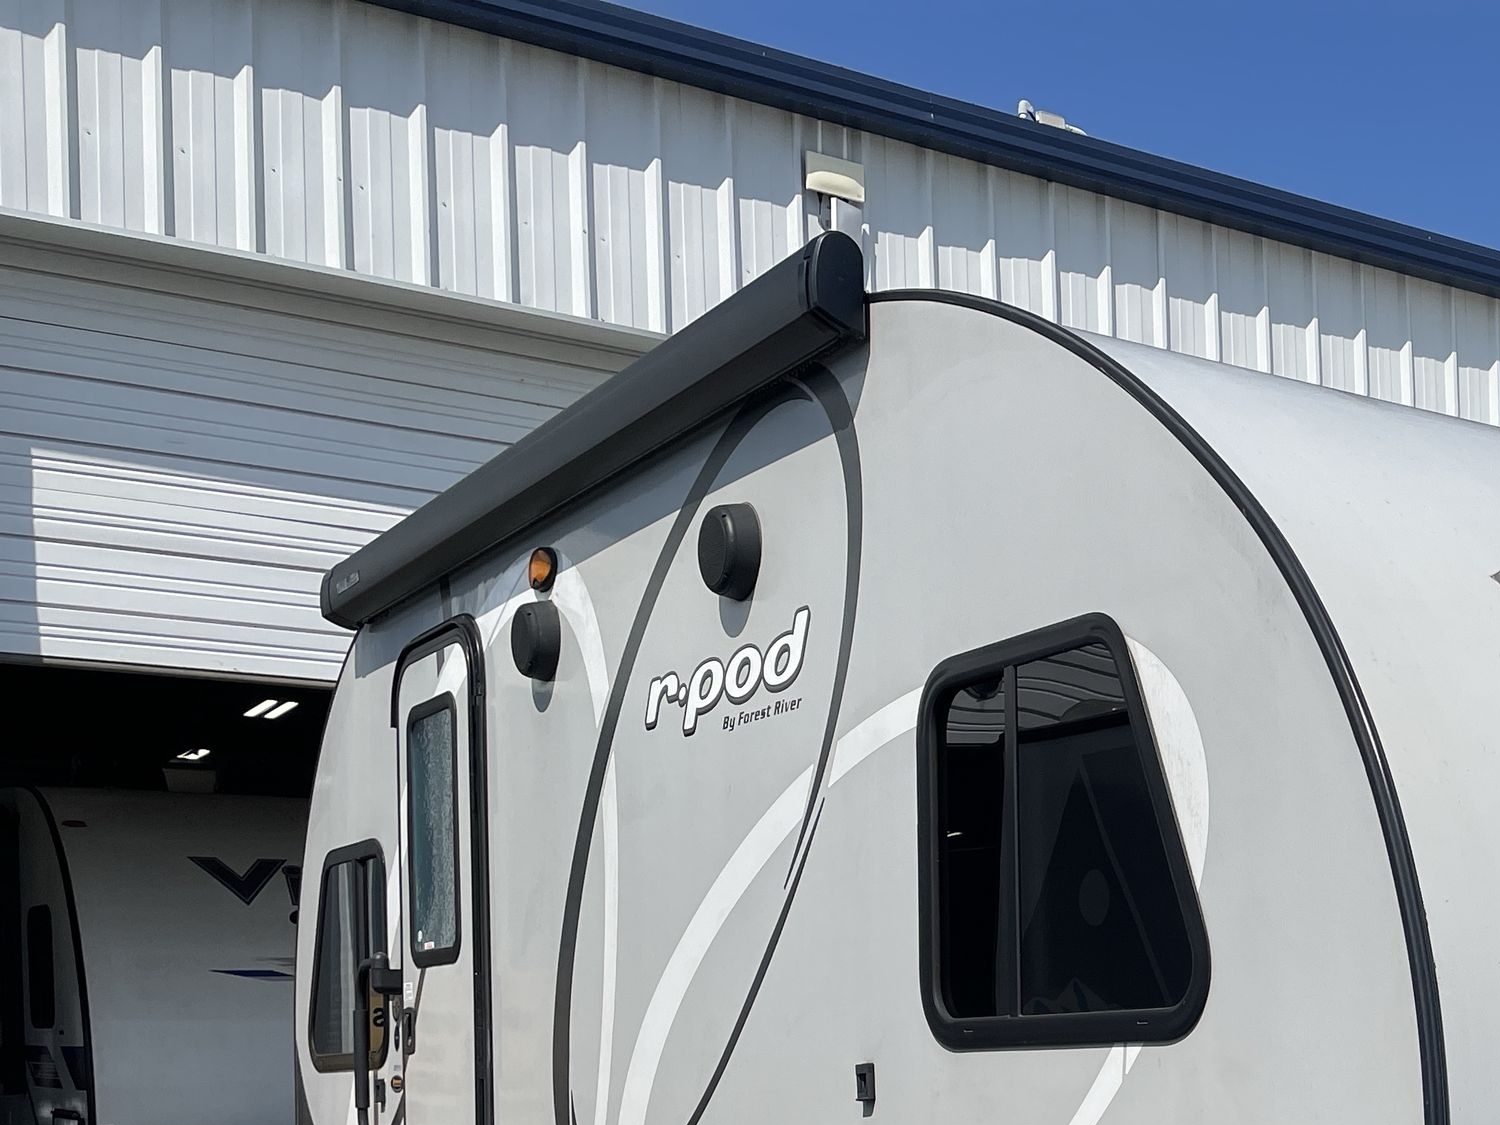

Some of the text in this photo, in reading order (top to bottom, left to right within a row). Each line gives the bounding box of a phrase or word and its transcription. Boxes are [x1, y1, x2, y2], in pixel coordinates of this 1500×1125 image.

[722, 697, 802, 732] By Forest River
